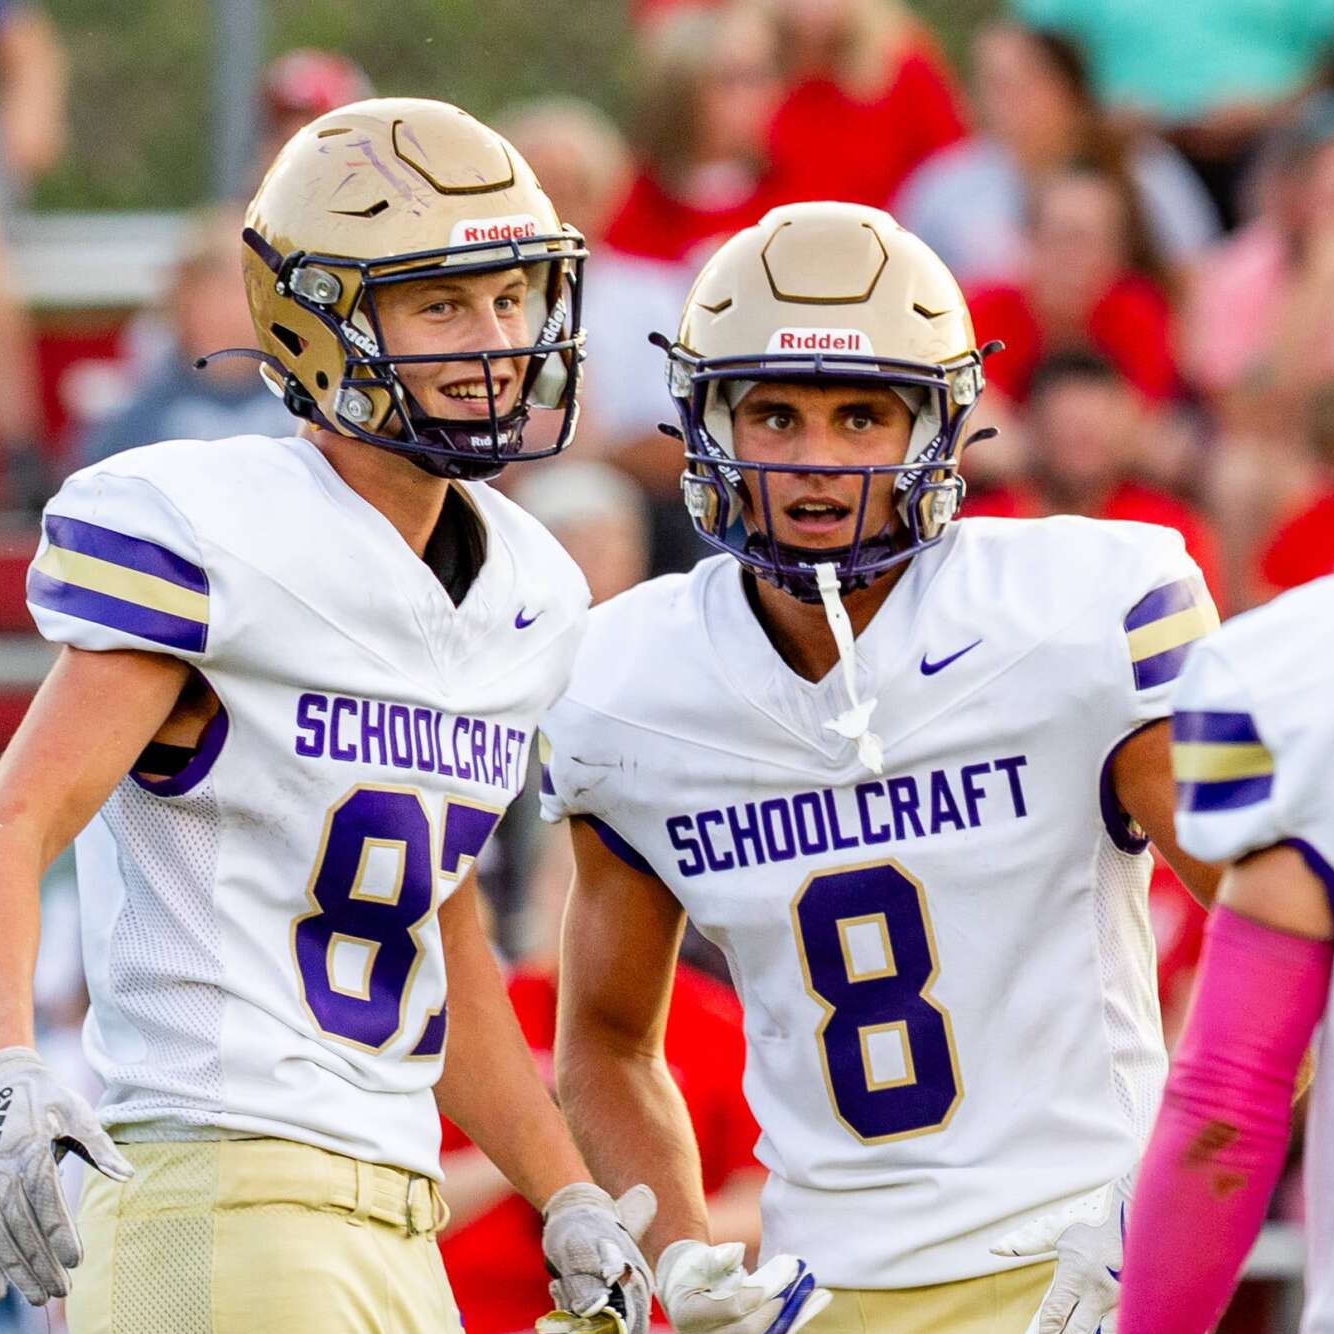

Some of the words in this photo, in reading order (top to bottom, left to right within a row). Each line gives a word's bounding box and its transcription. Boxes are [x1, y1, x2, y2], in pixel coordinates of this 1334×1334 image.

[464, 222, 535, 242] Riddell
[779, 333, 860, 350] Riddell
[295, 692, 526, 795] SCHOOLCRAFT
[666, 755, 1029, 878] SCHOOLCRAFT
[790, 856, 965, 1146] 8
